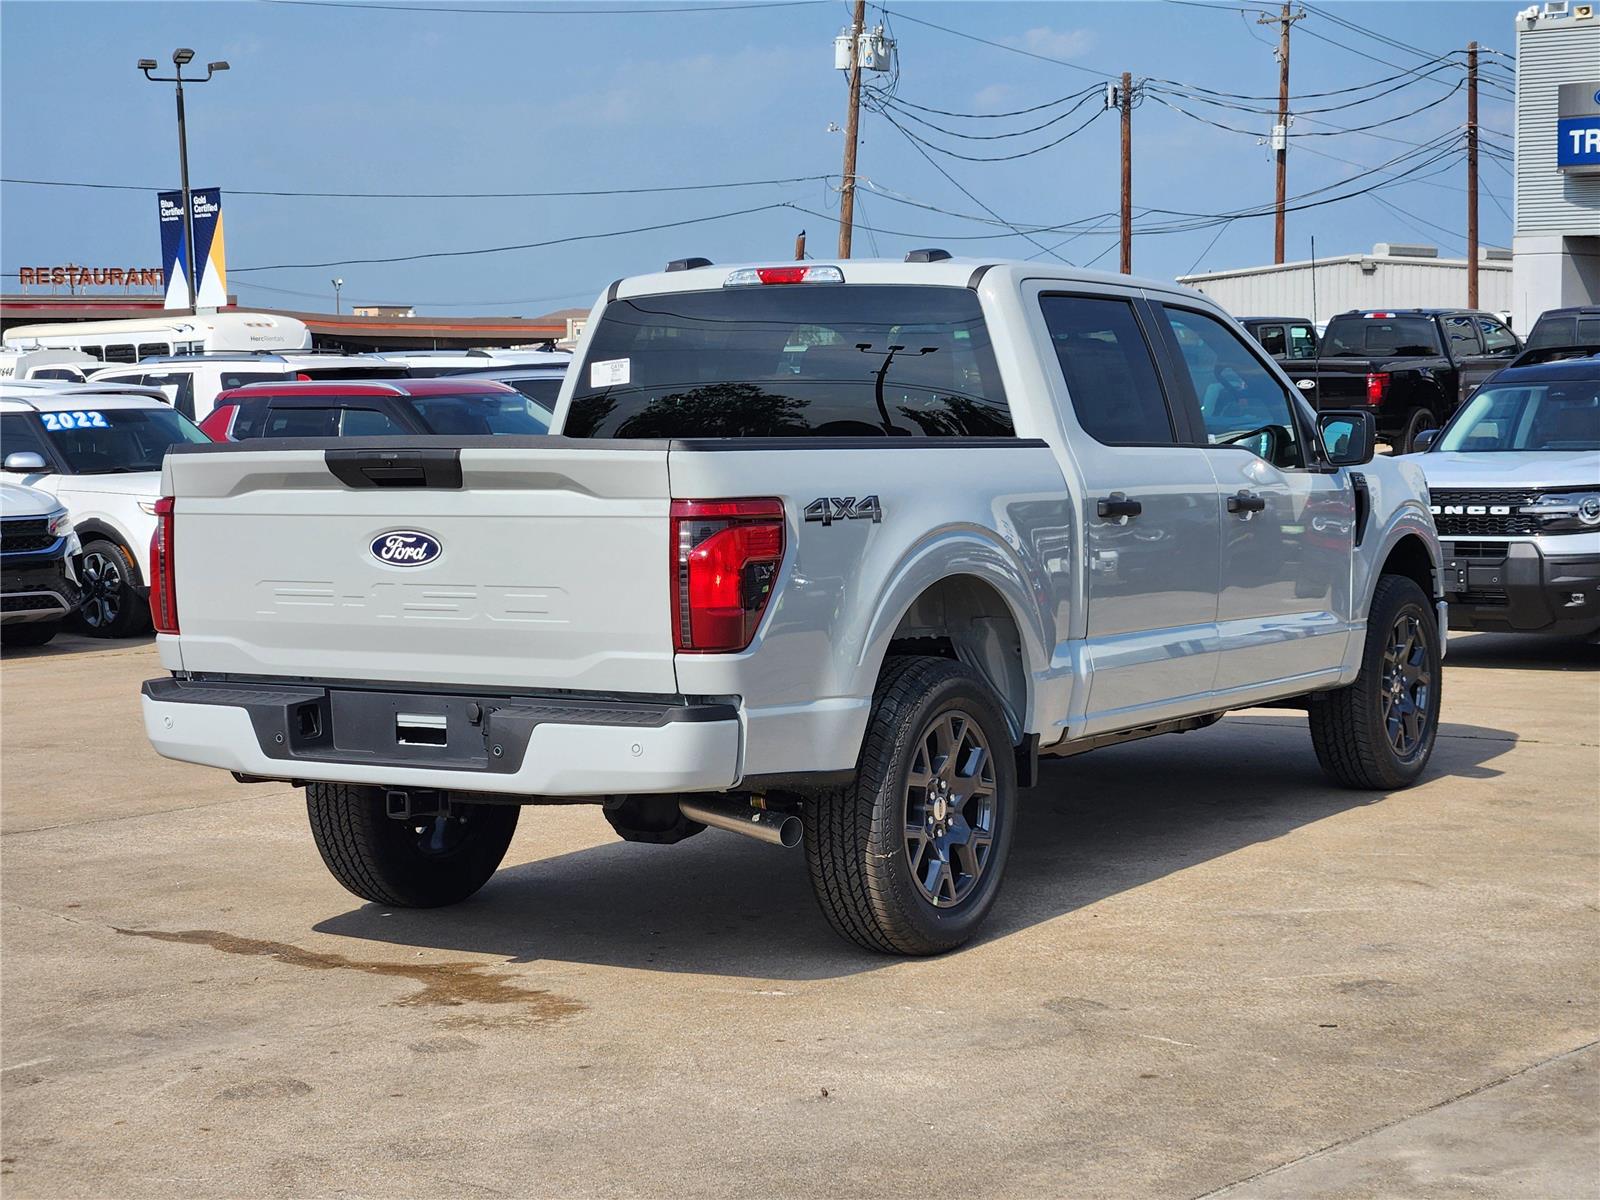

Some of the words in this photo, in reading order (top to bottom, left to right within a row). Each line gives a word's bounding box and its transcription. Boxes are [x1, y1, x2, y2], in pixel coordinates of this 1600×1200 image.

[160, 200, 174, 208] Blue
[193, 195, 207, 205] Gold
[161, 207, 185, 216] Certified
[193, 203, 218, 213] Certified
[19, 267, 164, 286] RESTAURANT
[41, 411, 109, 430] 2022
[804, 495, 882, 526] 4X4
[380, 534, 428, 561] Ford
